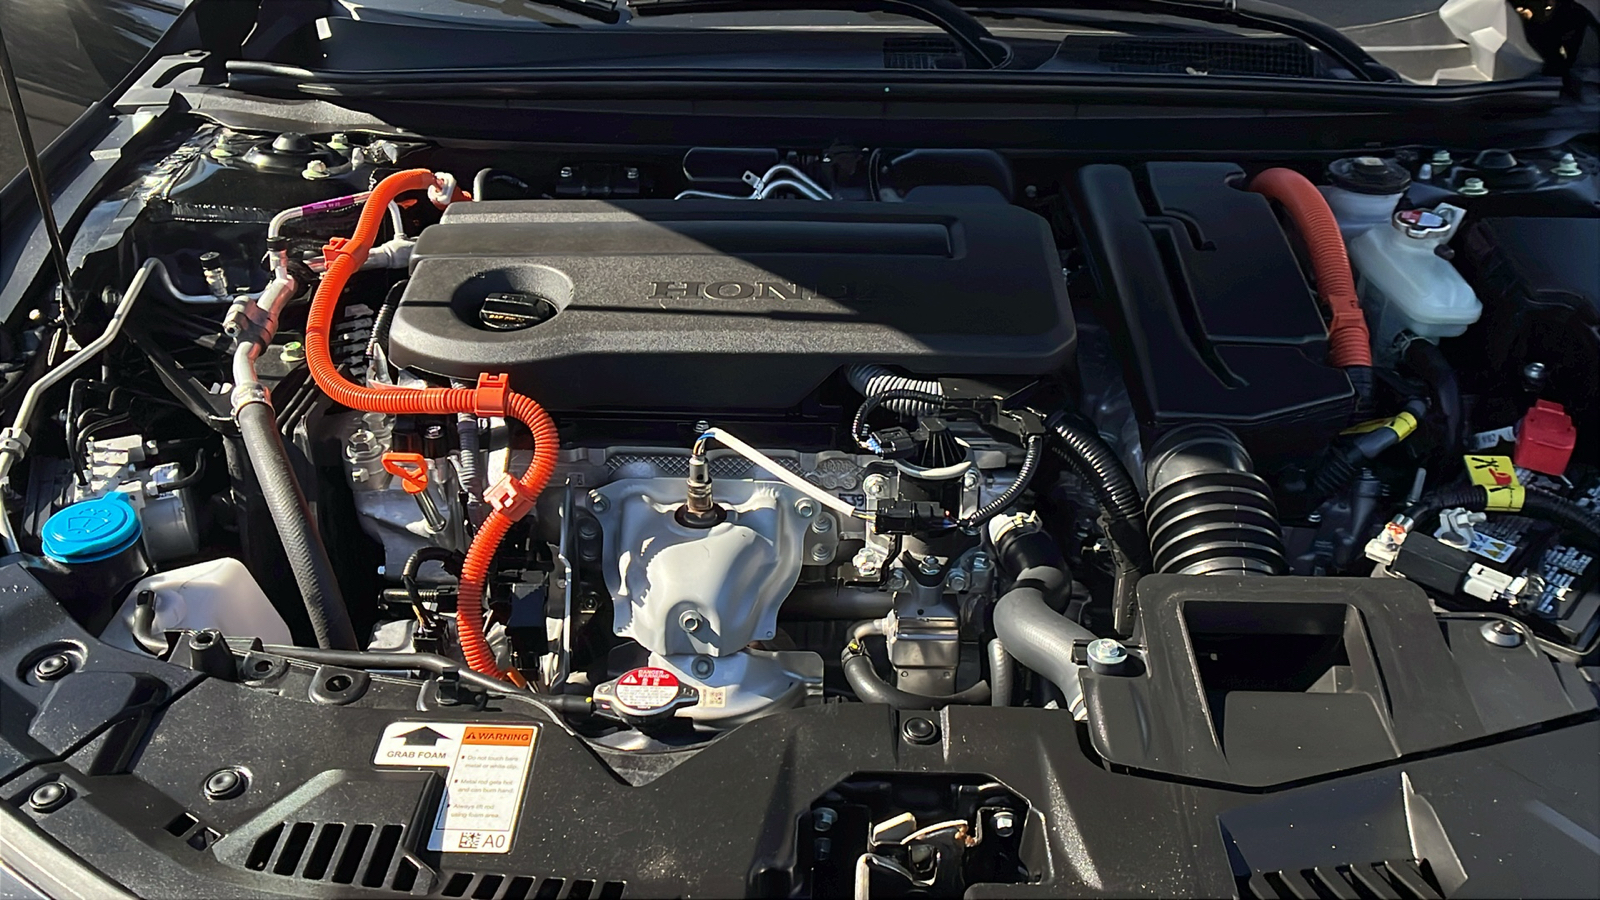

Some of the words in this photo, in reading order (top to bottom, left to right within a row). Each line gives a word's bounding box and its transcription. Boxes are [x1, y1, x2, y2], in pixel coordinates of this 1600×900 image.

[647, 280, 890, 301] HOND
[478, 732, 529, 741] WARNING
[386, 750, 415, 758] GRAB
[417, 751, 447, 759] FOAM
[482, 834, 506, 848] A0
